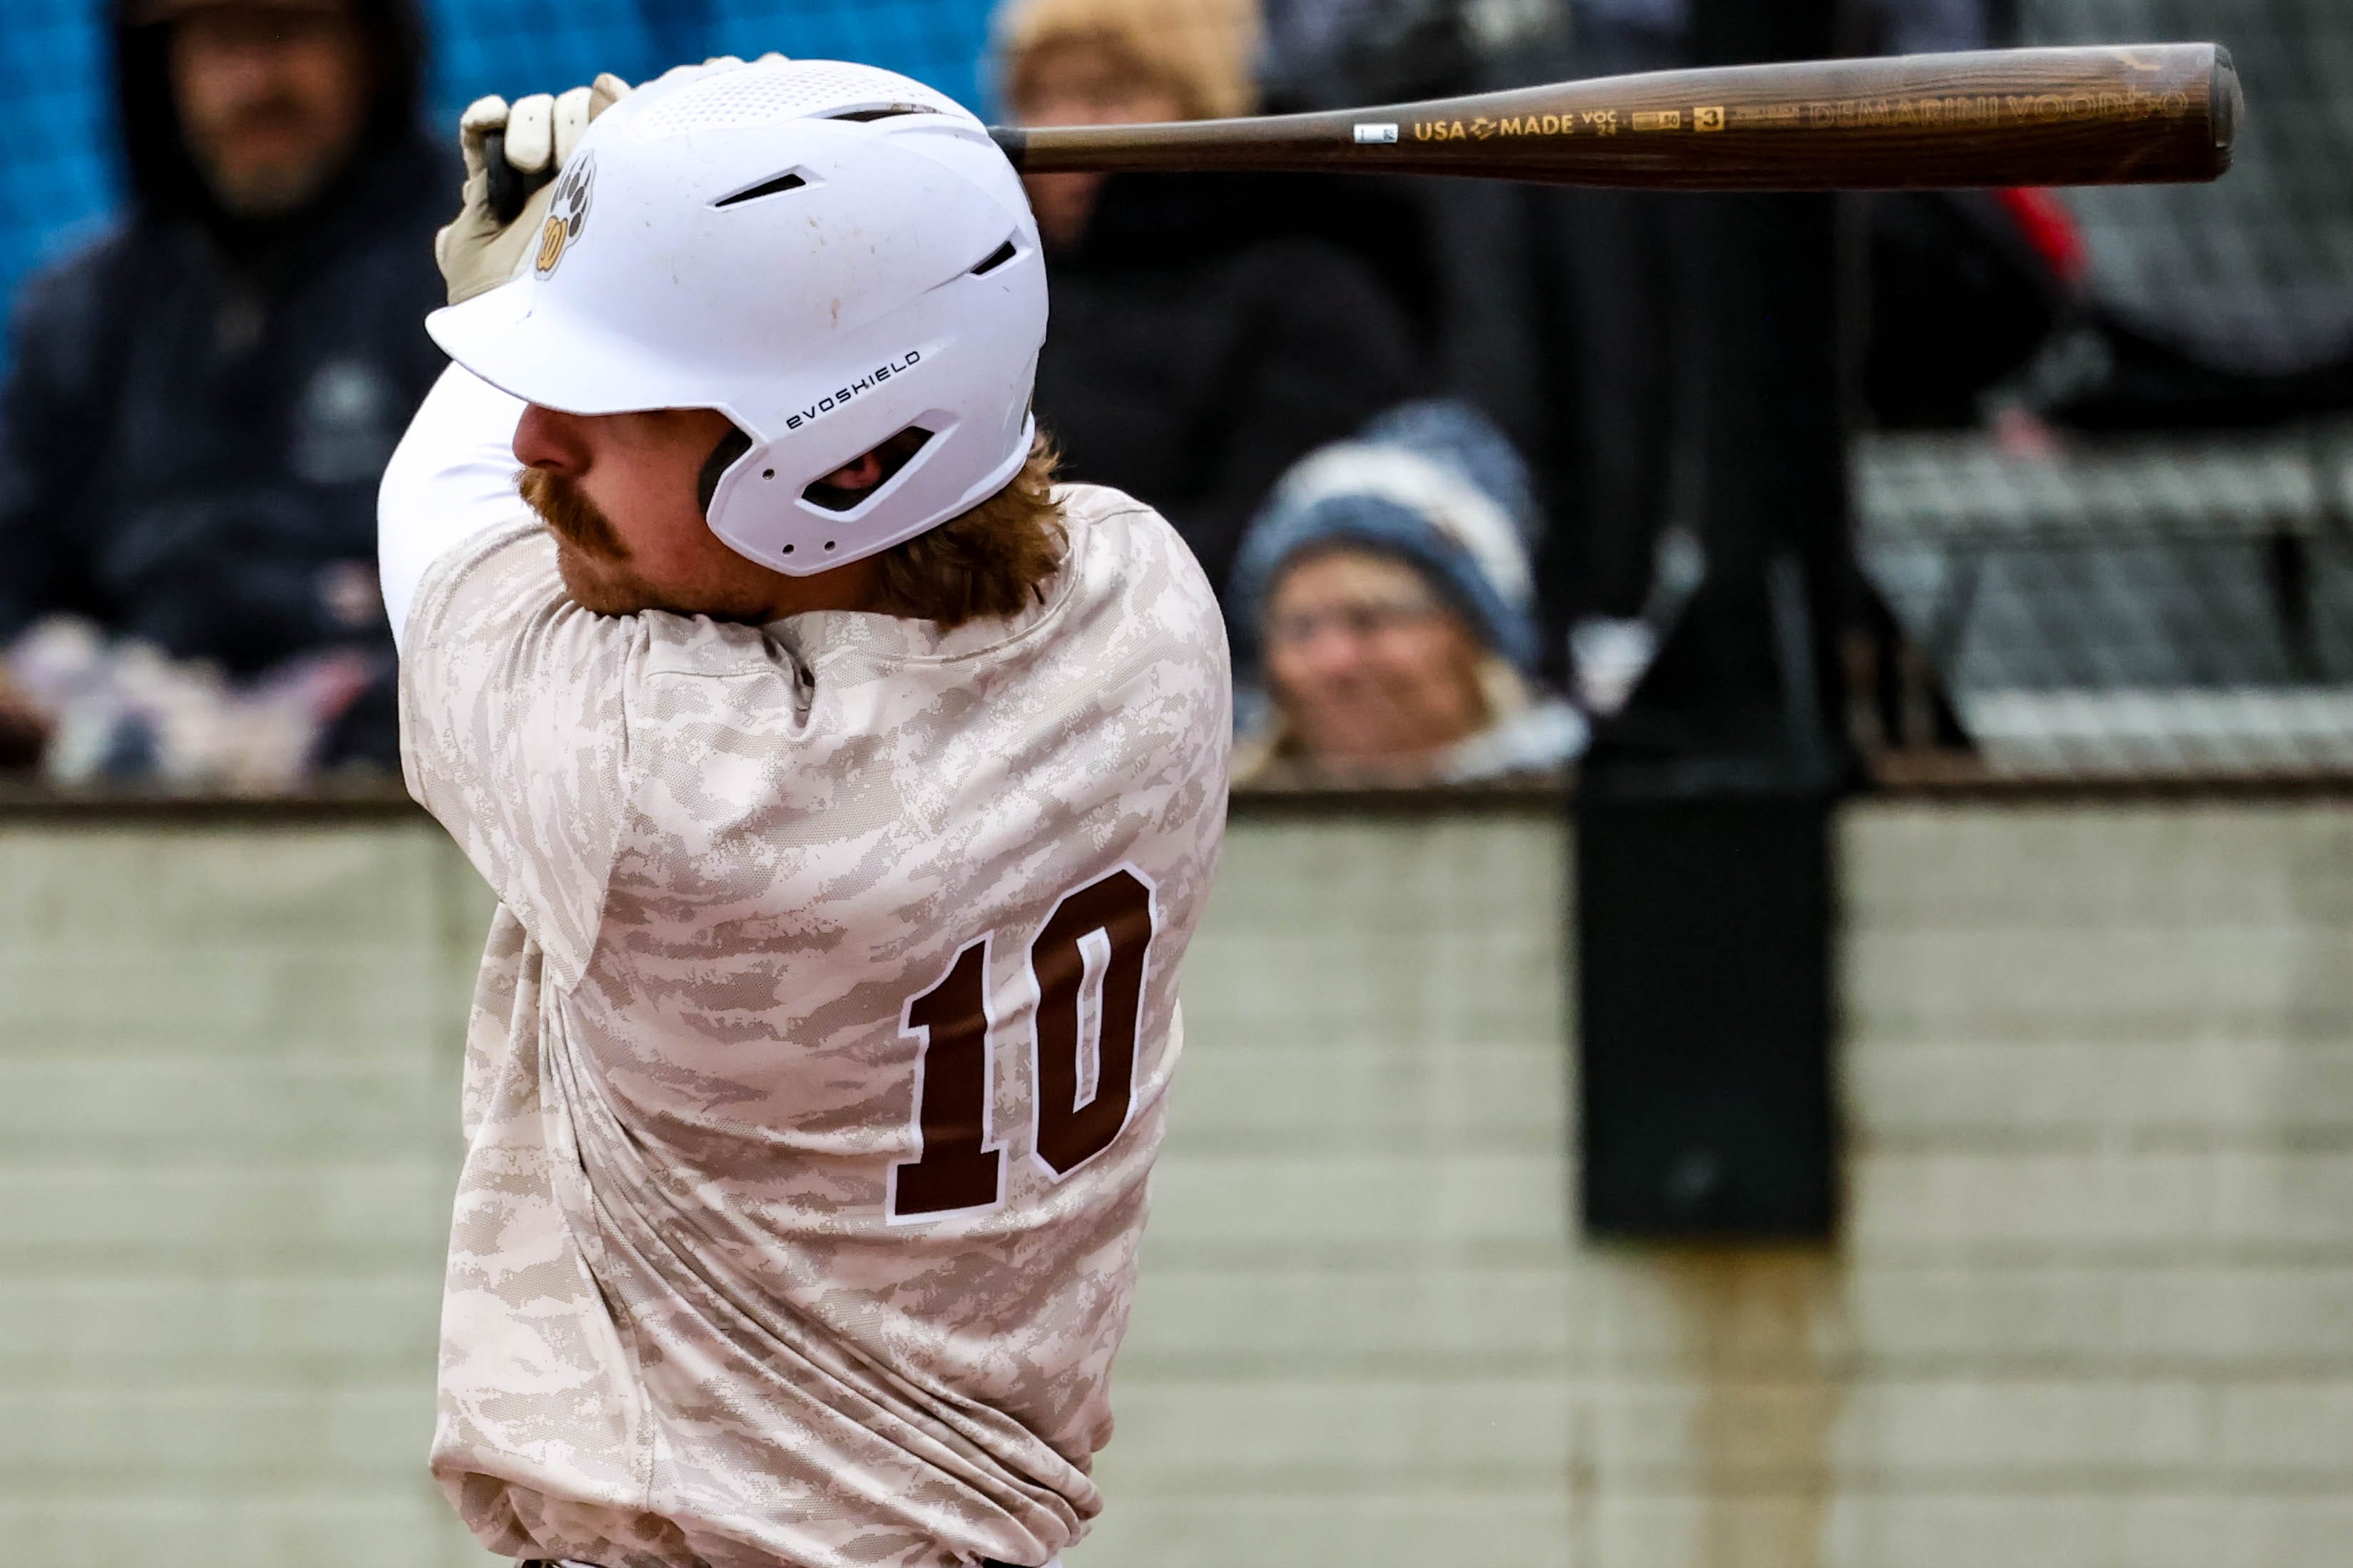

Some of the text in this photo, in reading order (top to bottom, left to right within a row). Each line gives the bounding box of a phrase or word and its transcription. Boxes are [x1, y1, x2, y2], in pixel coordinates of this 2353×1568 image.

[1414, 121, 1466, 141] USA
[1500, 114, 1574, 135] MADE
[1581, 111, 1617, 124] VOC
[887, 860, 1159, 1226] 10
